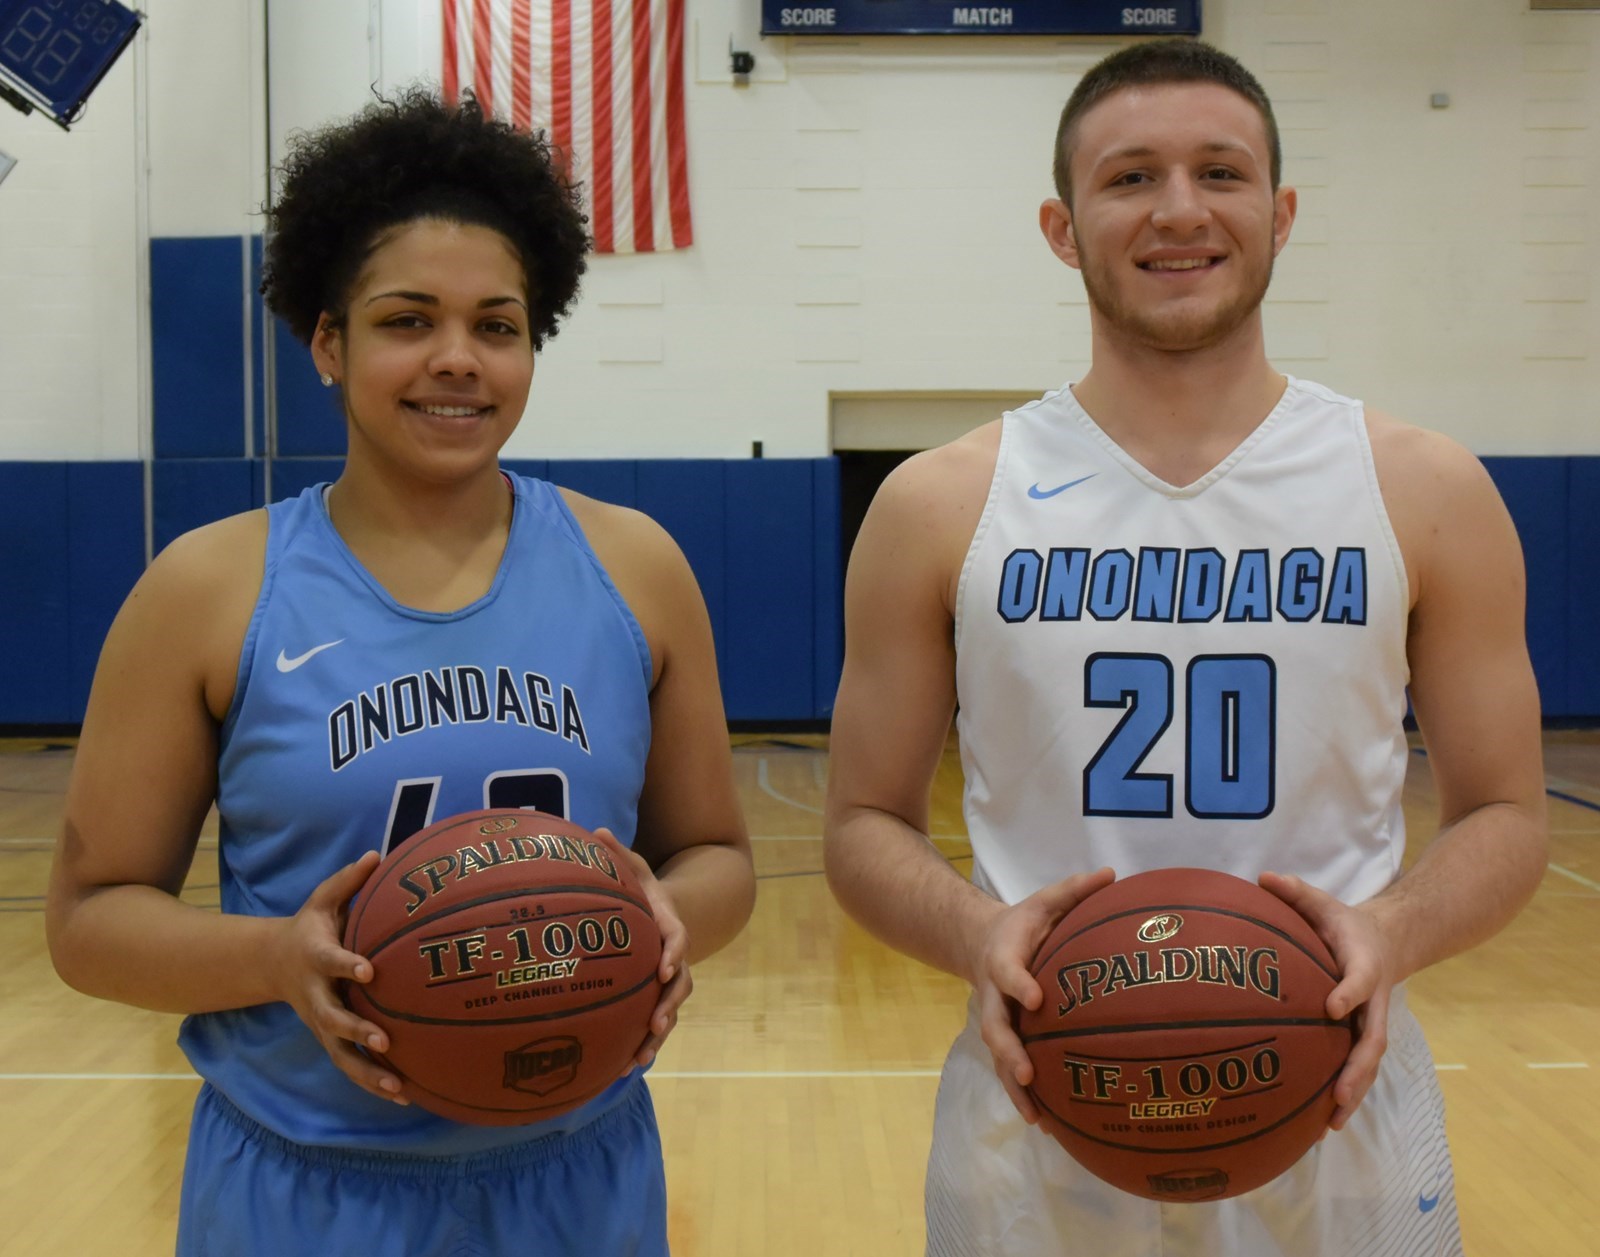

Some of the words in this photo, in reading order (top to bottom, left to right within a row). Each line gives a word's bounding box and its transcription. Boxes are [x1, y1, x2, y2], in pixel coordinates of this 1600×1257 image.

[781, 8, 836, 26] SCORE
[953, 8, 1013, 26] MATCH
[1122, 8, 1177, 26] SCORE
[997, 546, 1367, 626] ONONDAGA
[328, 665, 592, 773] ONONDAGA
[1082, 651, 1277, 820] 20
[399, 834, 620, 917] SPALDING
[419, 915, 631, 981] TF-1000
[464, 994, 499, 1010] DEEP
[503, 985, 565, 1003] CHANNEL
[570, 977, 614, 993] DESIGN
[496, 958, 581, 989] LEGACY
[1056, 945, 1281, 1018] SPALDING
[1063, 1047, 1281, 1100] TF-1000
[1129, 1097, 1217, 1120] LEGACY
[1136, 1122, 1201, 1134] CHANNEL
[1206, 1113, 1257, 1130] DESIGN
